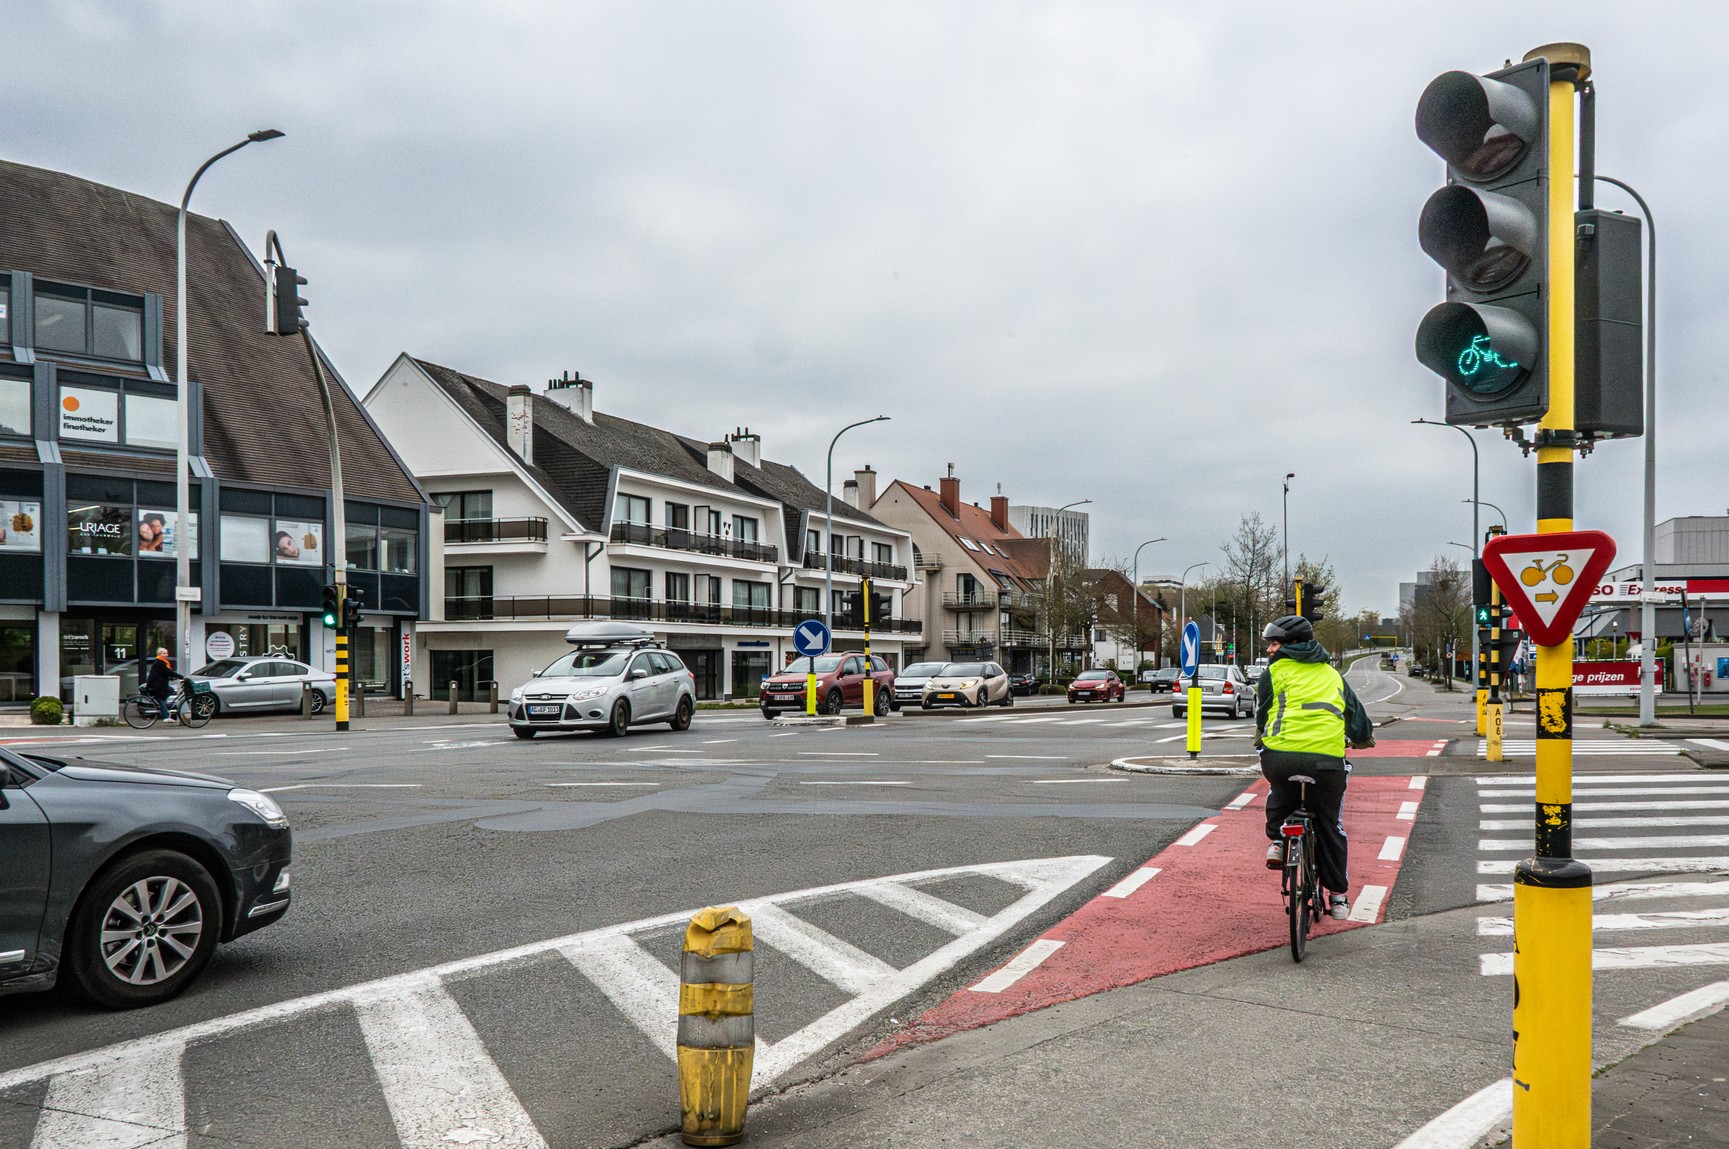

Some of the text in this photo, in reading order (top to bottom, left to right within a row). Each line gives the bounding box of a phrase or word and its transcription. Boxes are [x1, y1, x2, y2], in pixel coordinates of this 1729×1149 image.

[63, 413, 114, 425] immotheker
[63, 422, 106, 433] finotheker
[80, 522, 120, 534] URIAGE
[1627, 584, 1682, 595] Exress
[115, 648, 126, 659] 11
[1587, 672, 1625, 683] prijzen
